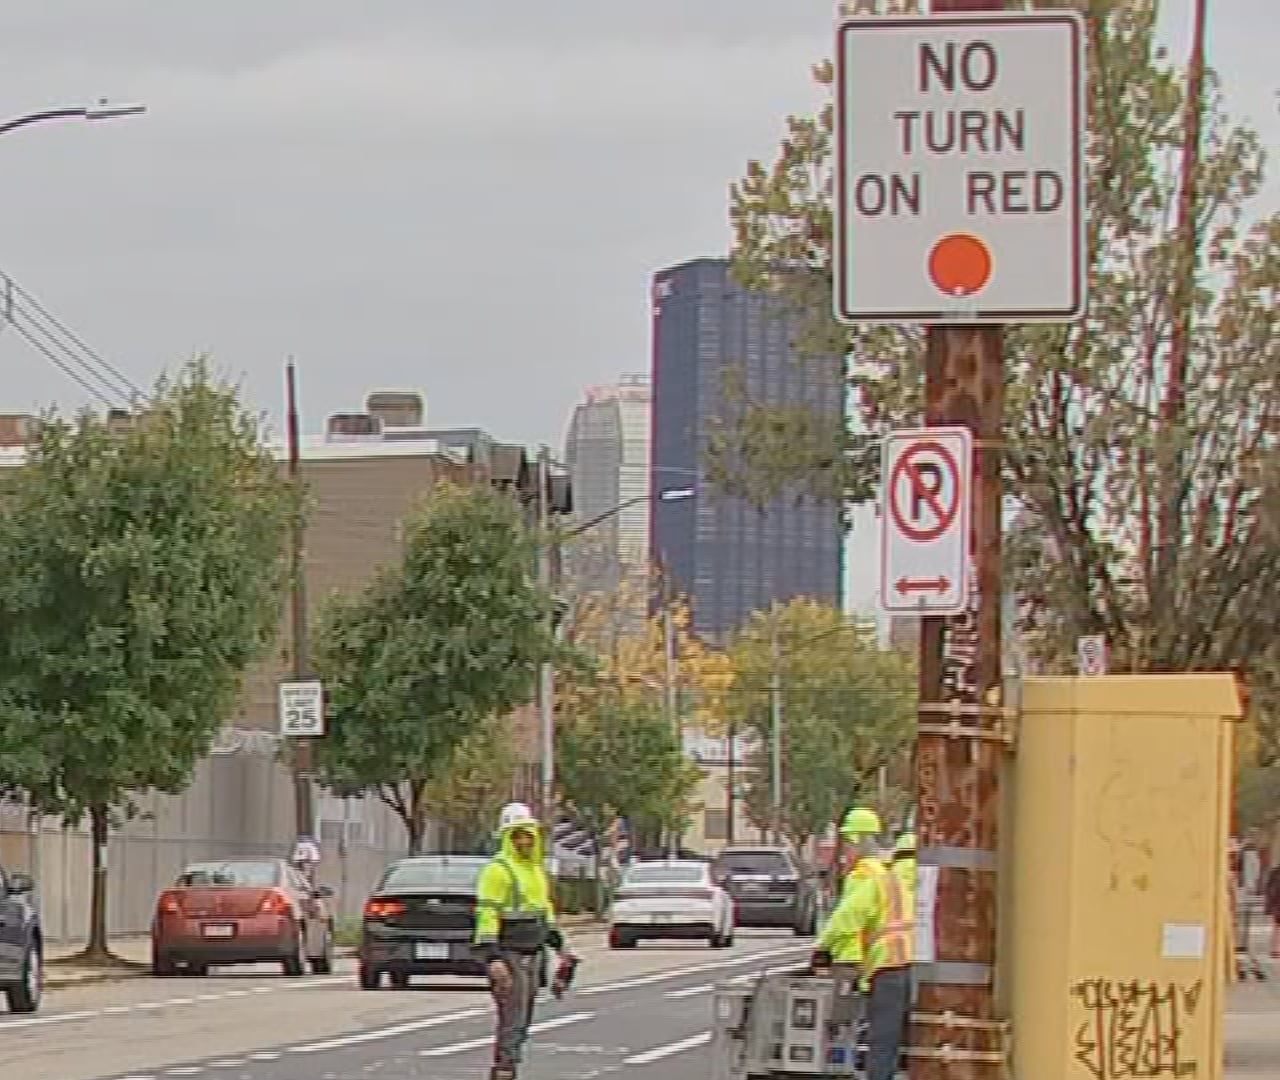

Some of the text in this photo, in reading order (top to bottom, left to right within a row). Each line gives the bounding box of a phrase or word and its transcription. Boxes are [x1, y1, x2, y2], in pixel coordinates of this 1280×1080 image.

[917, 40, 998, 93] NO
[893, 109, 1025, 155] TURN
[854, 170, 1064, 216] ON RED
[285, 708, 317, 731] 25
